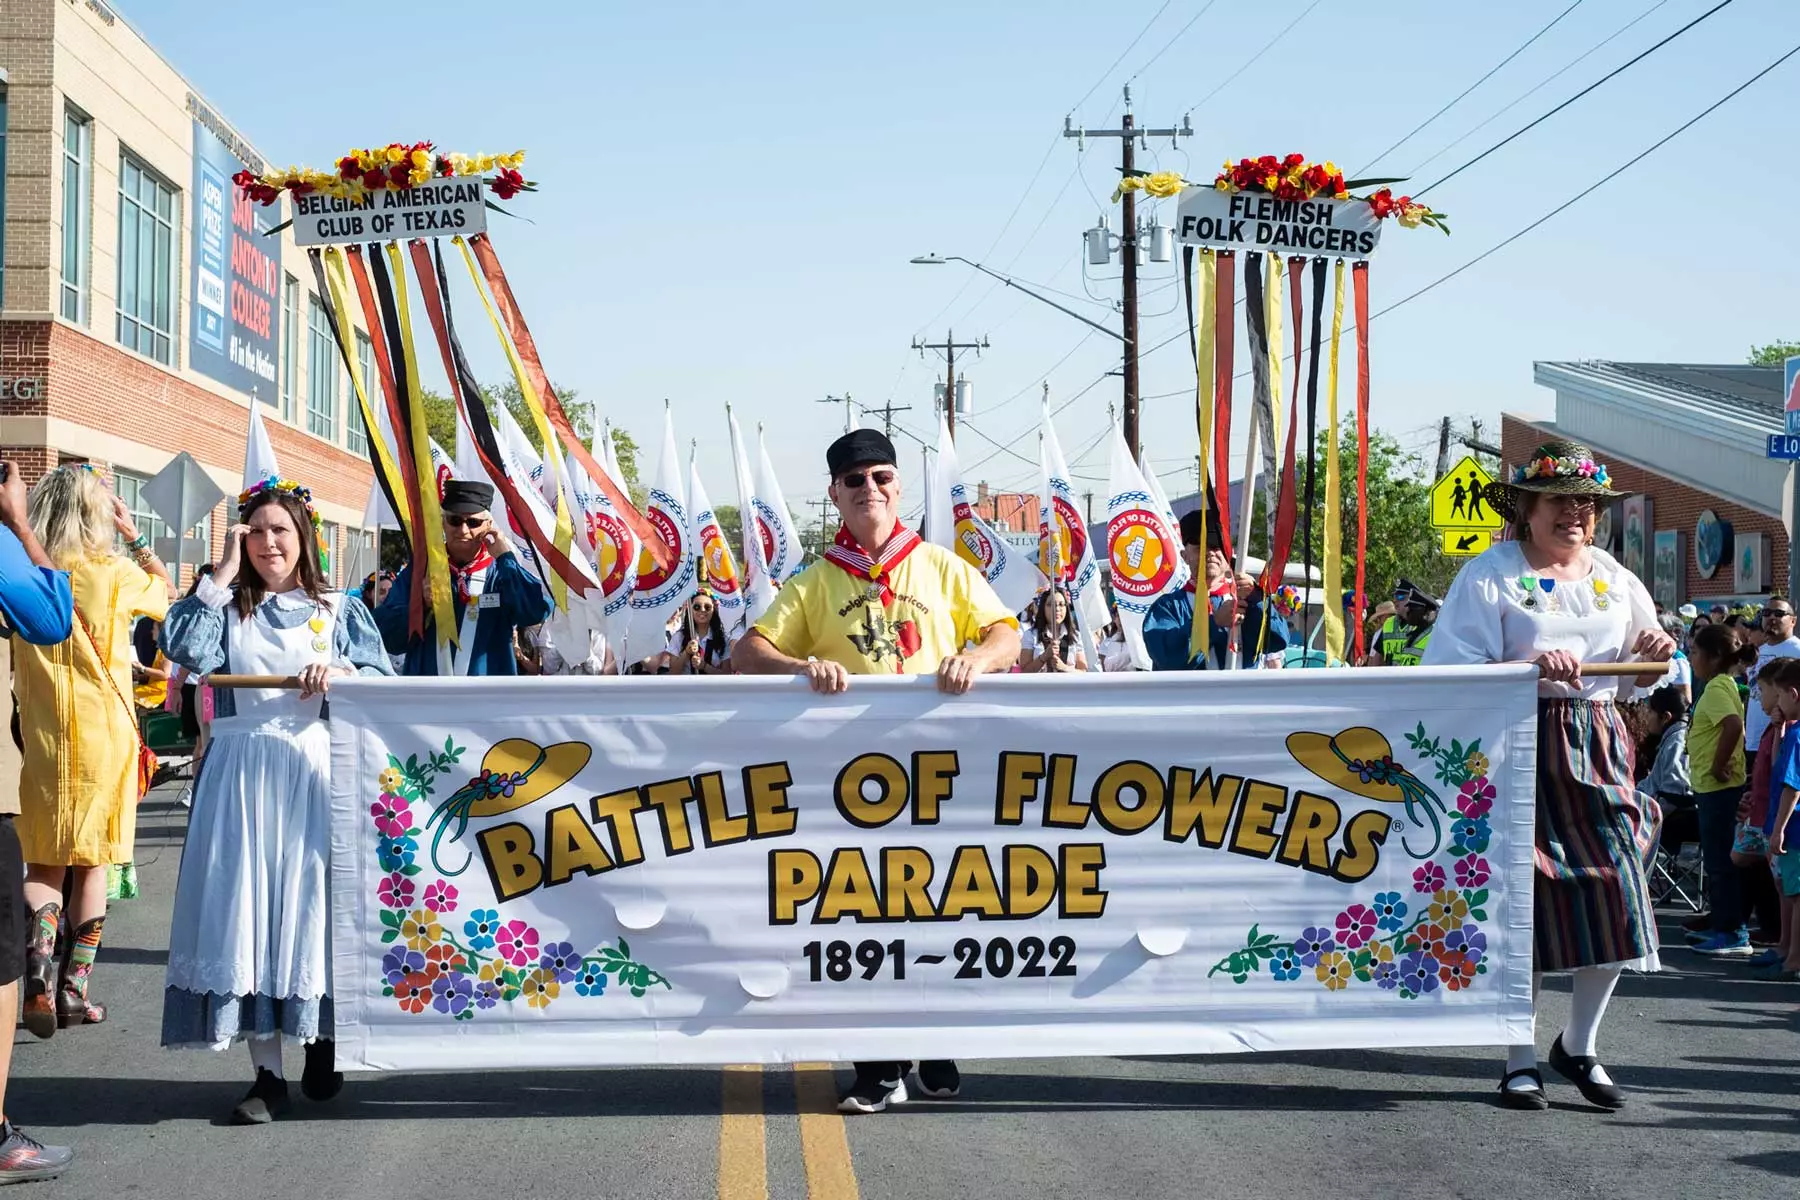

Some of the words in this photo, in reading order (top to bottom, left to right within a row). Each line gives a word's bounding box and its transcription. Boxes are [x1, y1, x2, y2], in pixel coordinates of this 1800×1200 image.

[203, 178, 222, 212] ASPEN
[383, 183, 481, 209] AMERICAN
[1229, 196, 1334, 226] FLEMISH
[203, 204, 222, 240] PRIZE
[316, 216, 364, 238] CLUB
[371, 214, 395, 234] OF
[402, 208, 466, 232] TEXAS
[1181, 215, 1246, 242] FOLK
[1256, 222, 1375, 254] DANCERS
[231, 280, 271, 340] COLLEGE
[245, 341, 256, 373] the
[255, 348, 275, 383] Nation
[1771, 435, 1778, 453] E
[475, 760, 799, 904] BATTLE
[833, 750, 960, 829] OF
[768, 843, 1109, 926] PARADE
